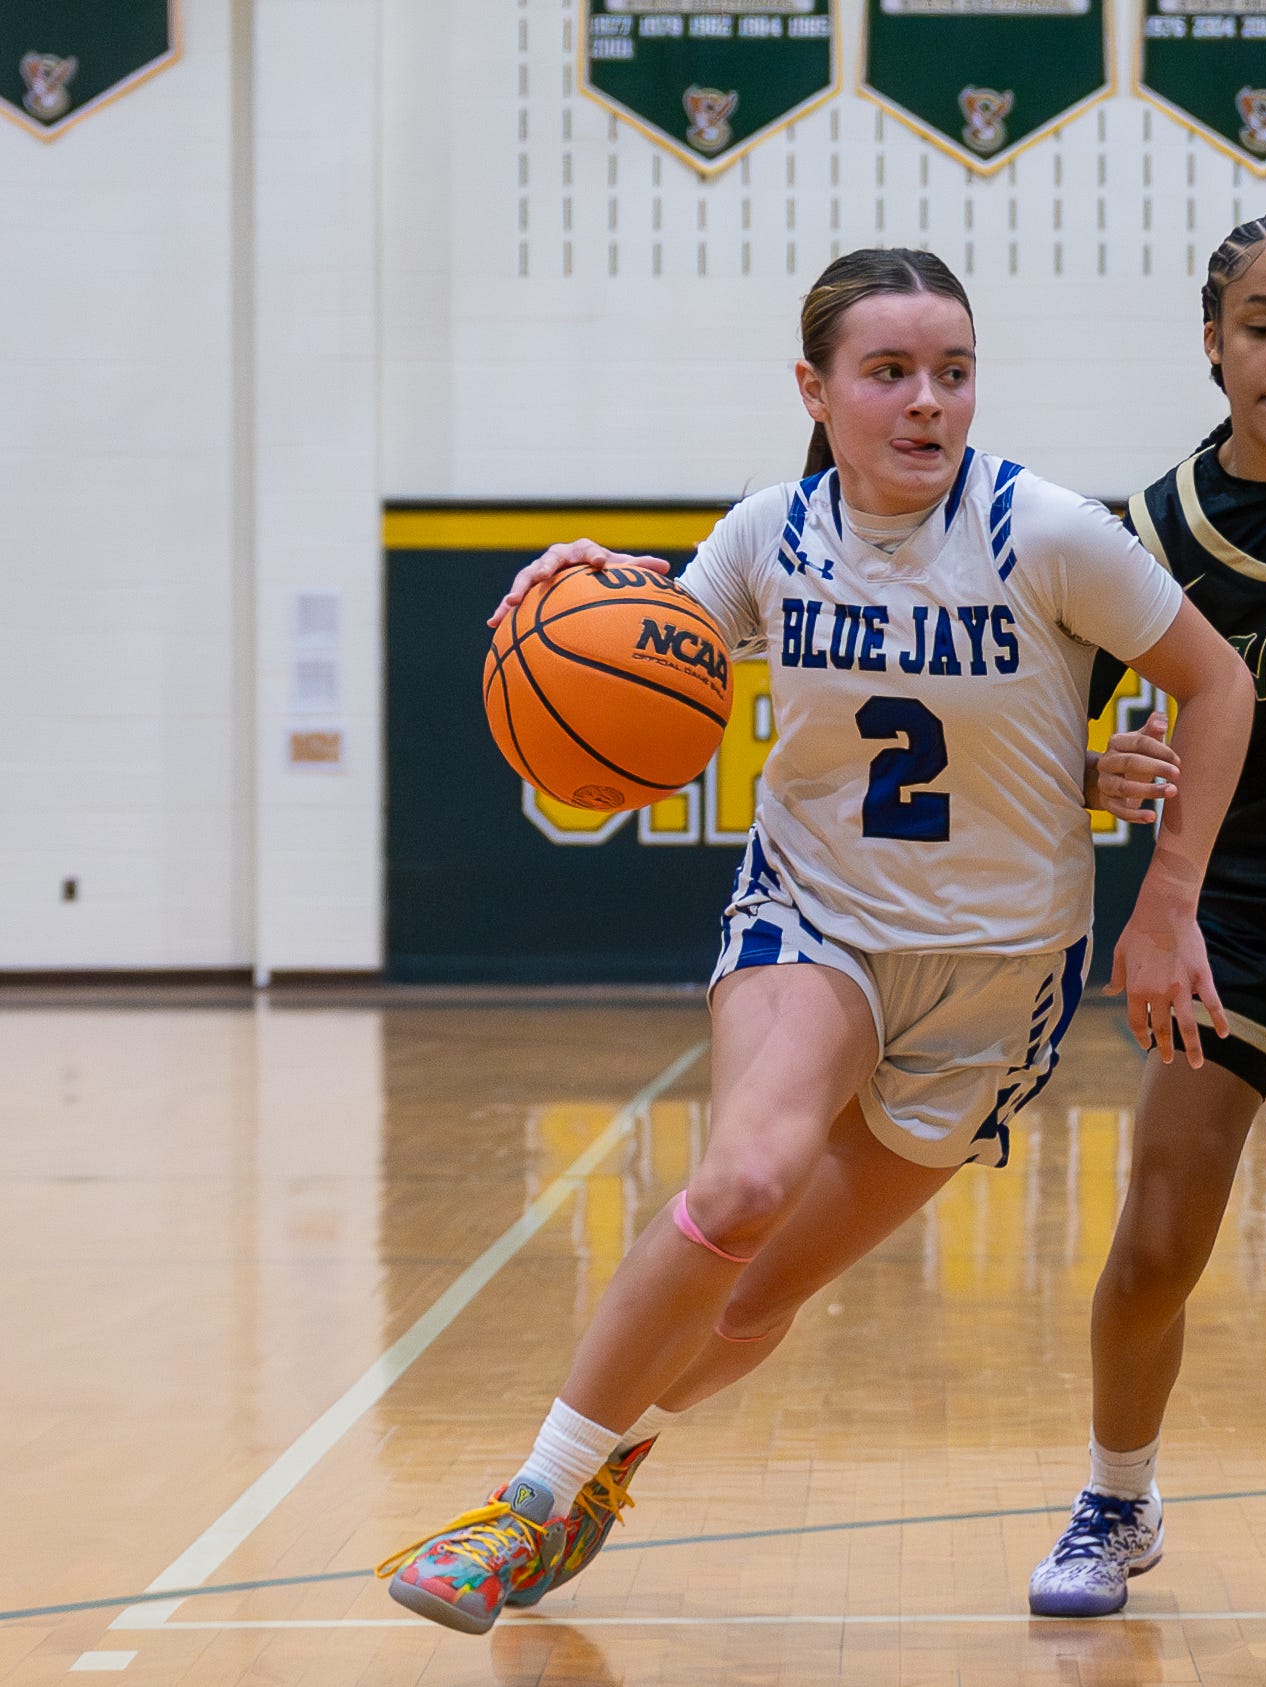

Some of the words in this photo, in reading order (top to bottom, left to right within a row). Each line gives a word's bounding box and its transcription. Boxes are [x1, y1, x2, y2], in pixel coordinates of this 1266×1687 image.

[635, 617, 728, 691] NCAA
[781, 597, 890, 672] BLUE
[899, 604, 1020, 677] JAYS
[854, 695, 951, 842] 2
